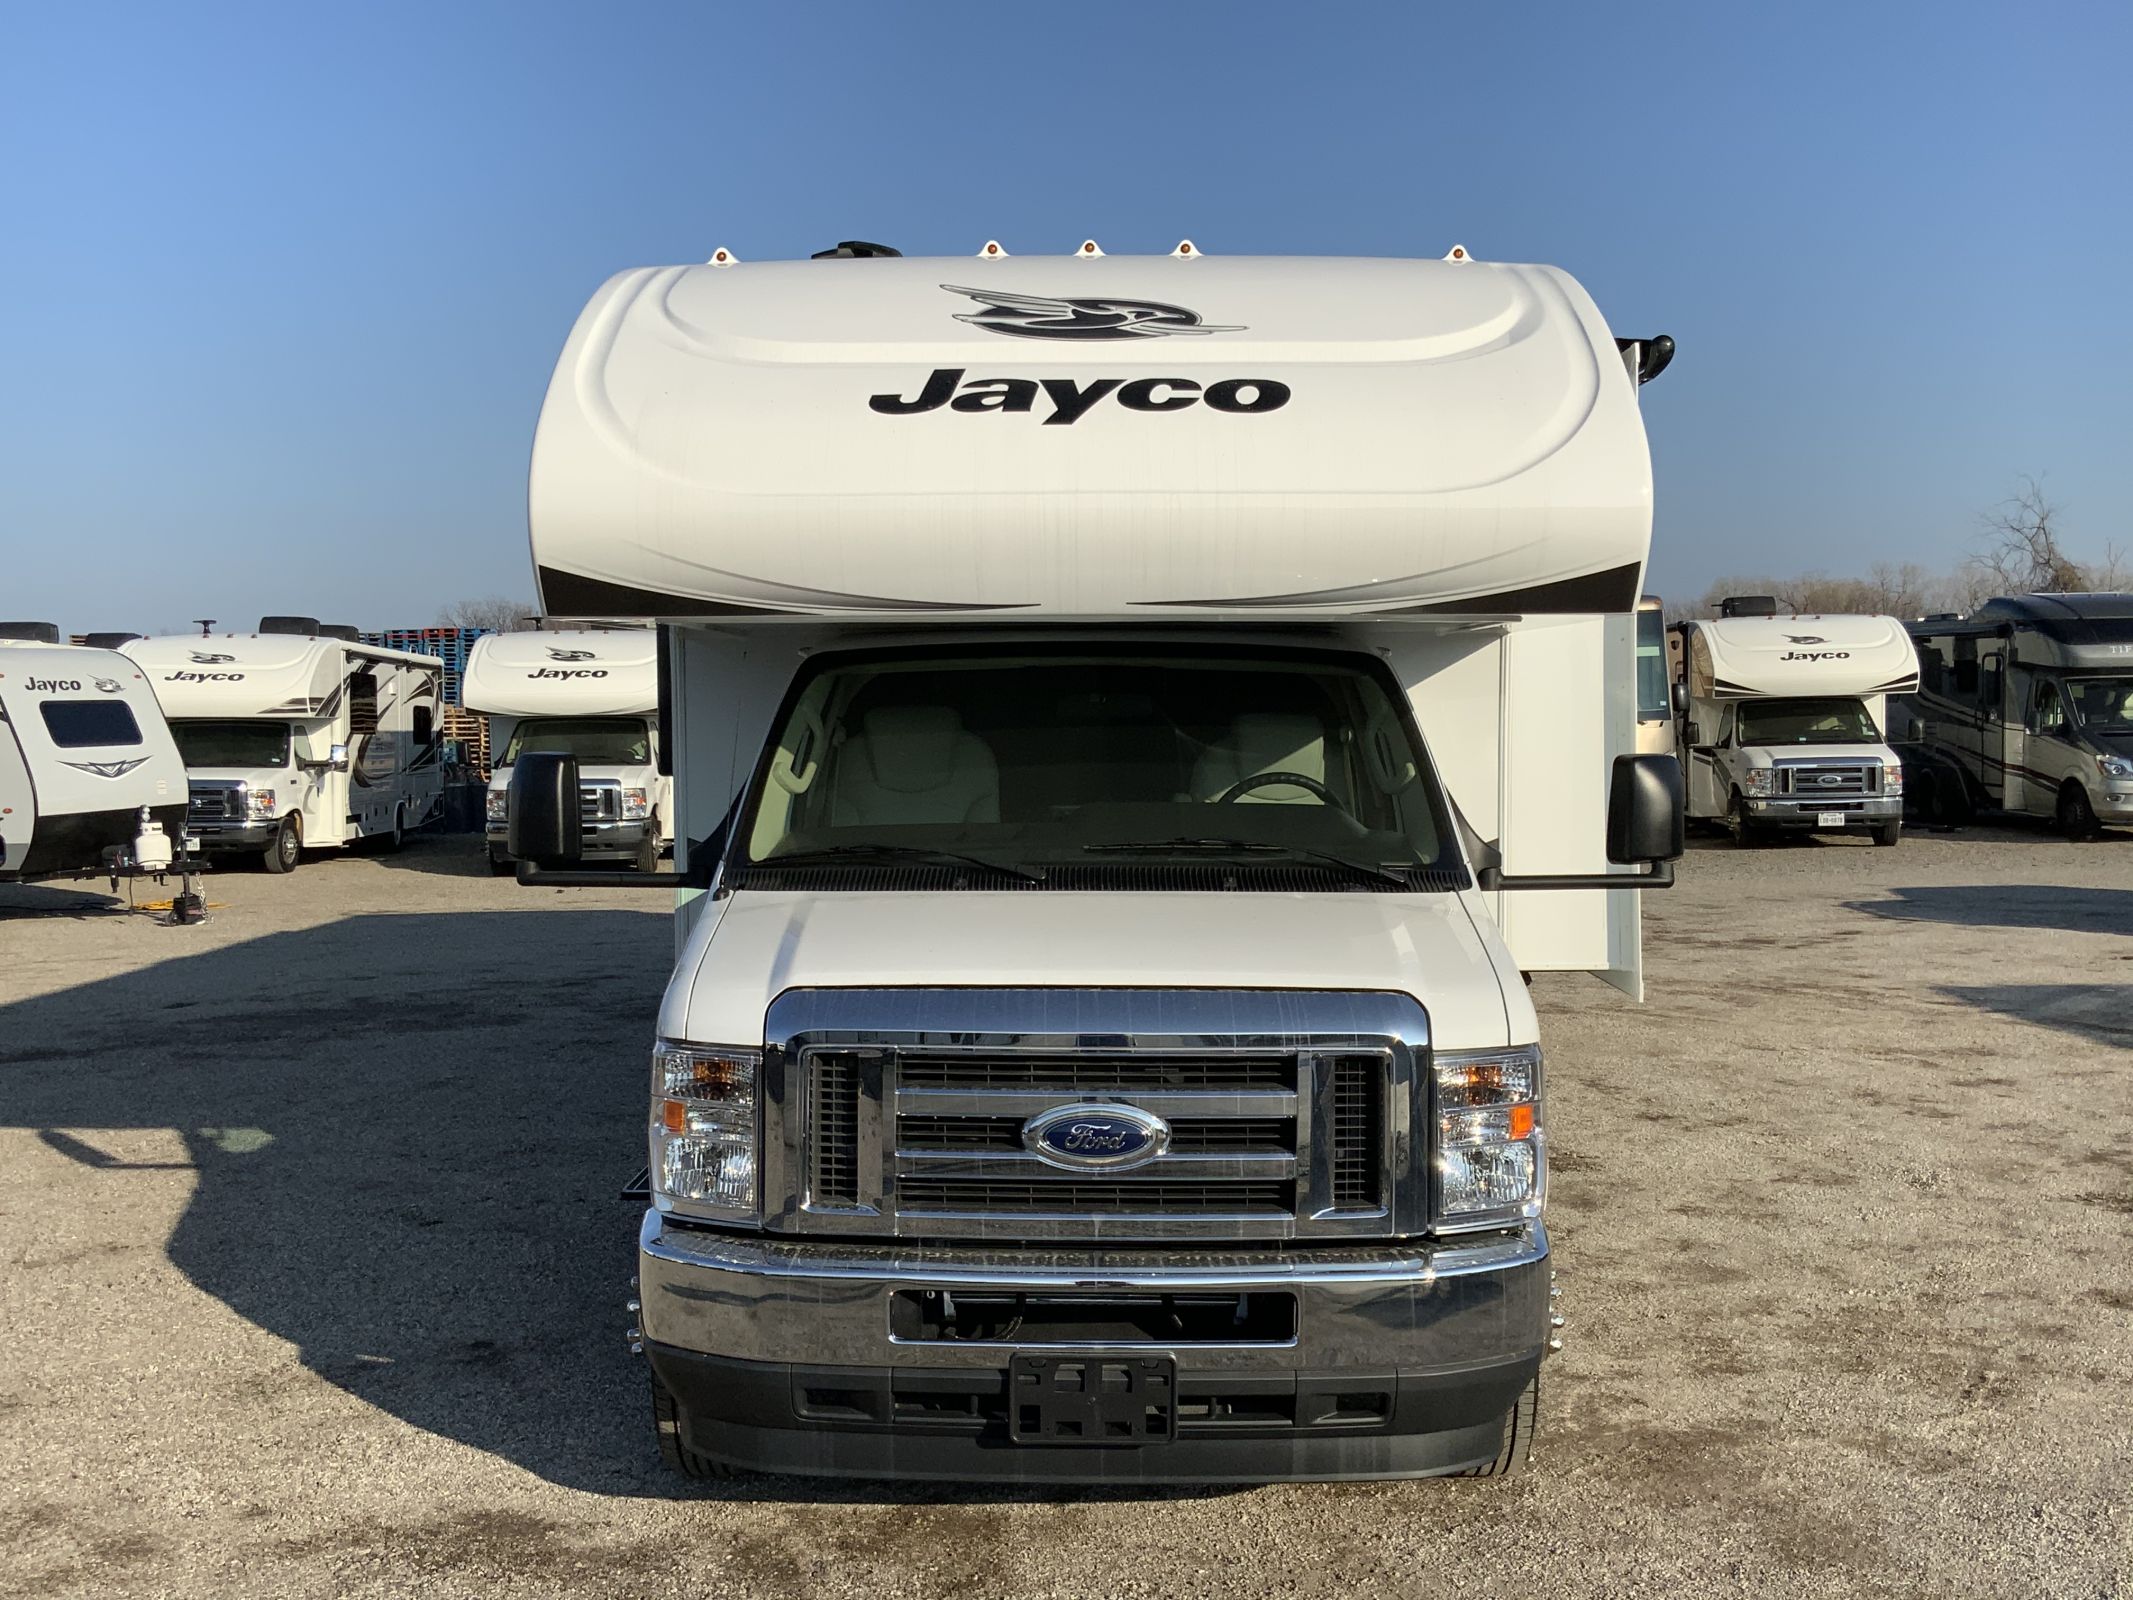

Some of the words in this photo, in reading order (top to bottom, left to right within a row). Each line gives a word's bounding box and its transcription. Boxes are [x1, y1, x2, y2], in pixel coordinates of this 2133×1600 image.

[868, 368, 1292, 425] Jayco
[1779, 652, 1850, 662] Jayco
[164, 671, 245, 683] Jayco
[527, 668, 609, 681] Jayco
[24, 676, 81, 693] Jayco
[1064, 1123, 1127, 1150] Ford
